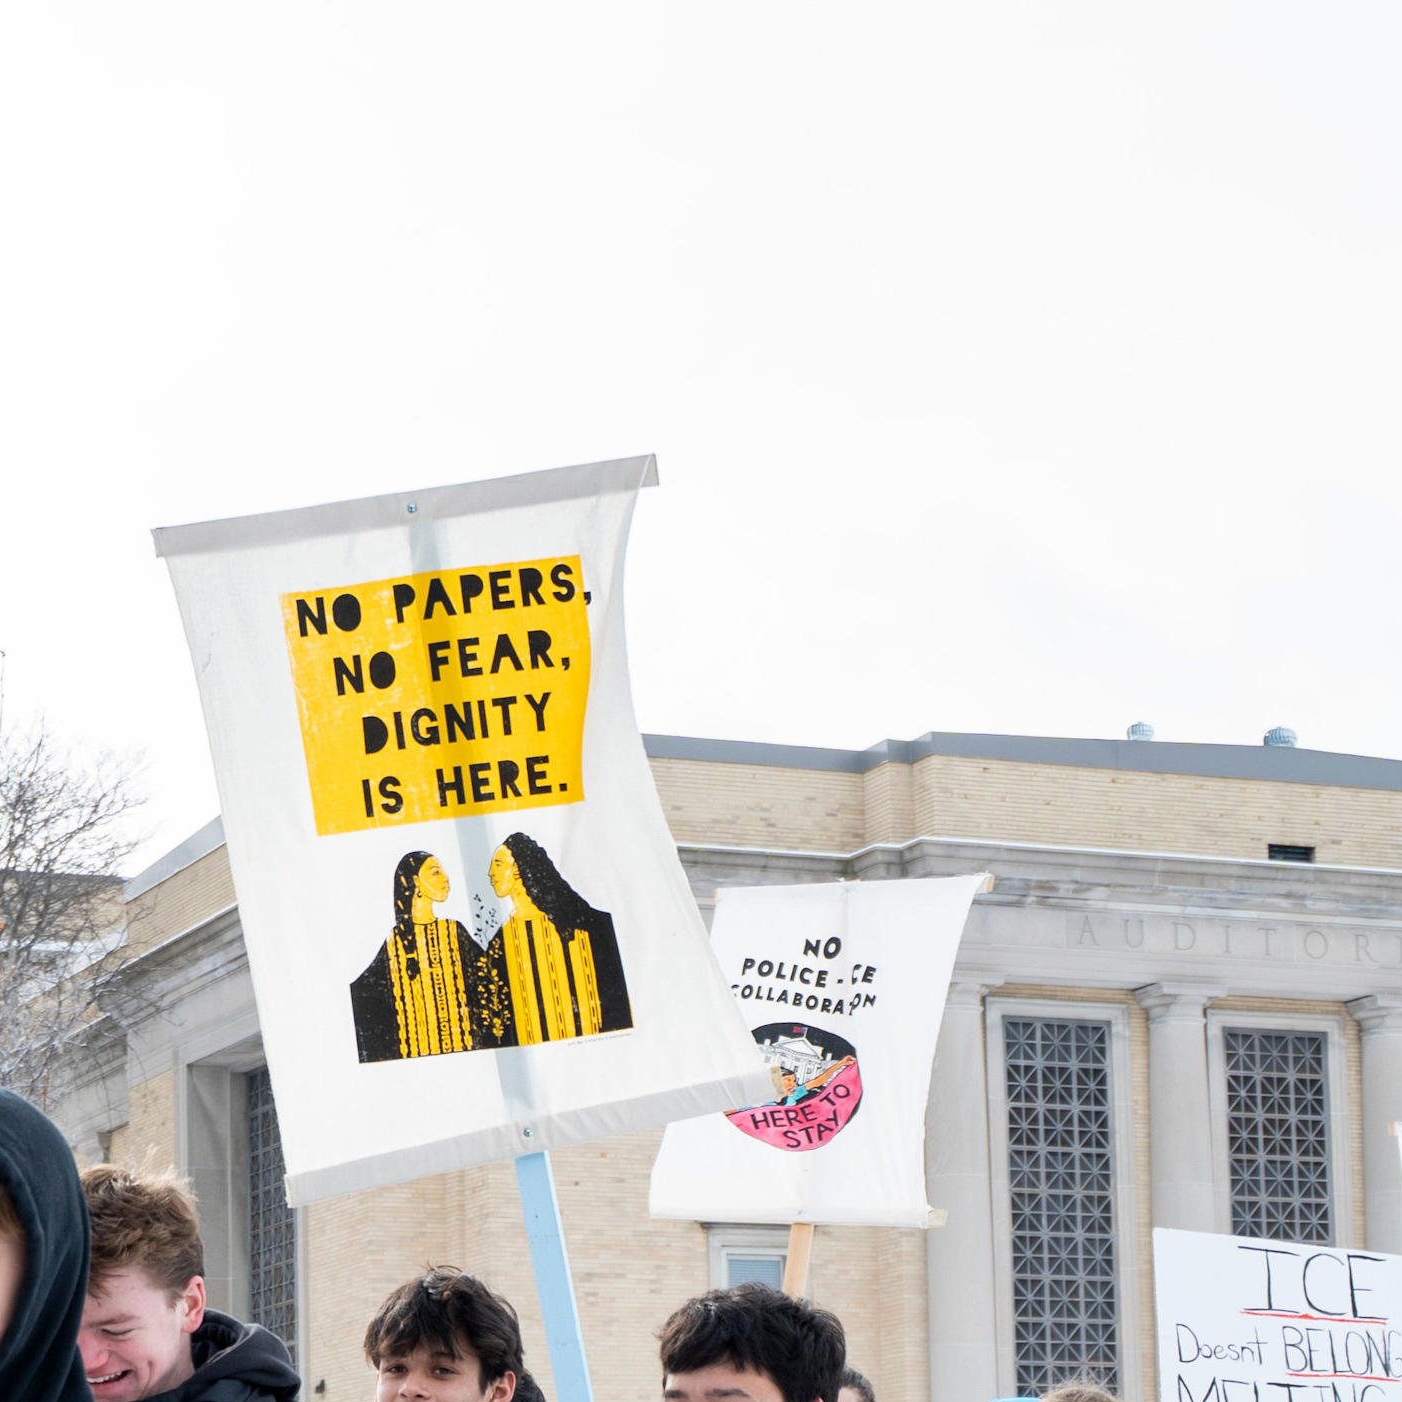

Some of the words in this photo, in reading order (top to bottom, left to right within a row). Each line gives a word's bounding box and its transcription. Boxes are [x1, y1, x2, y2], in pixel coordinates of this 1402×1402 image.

[296, 593, 362, 637] NO
[393, 563, 592, 623] PAPERS,
[333, 651, 396, 696] NO
[428, 630, 570, 682] FEAR,
[362, 692, 551, 755] DIGNITY
[362, 775, 403, 818] IS
[436, 755, 568, 807] HERE.
[803, 936, 842, 960] NO
[750, 1104, 818, 1130] HERE
[819, 1084, 850, 1107] TO
[782, 1109, 839, 1149] STAY
[1237, 1246, 1389, 1320] ICE
